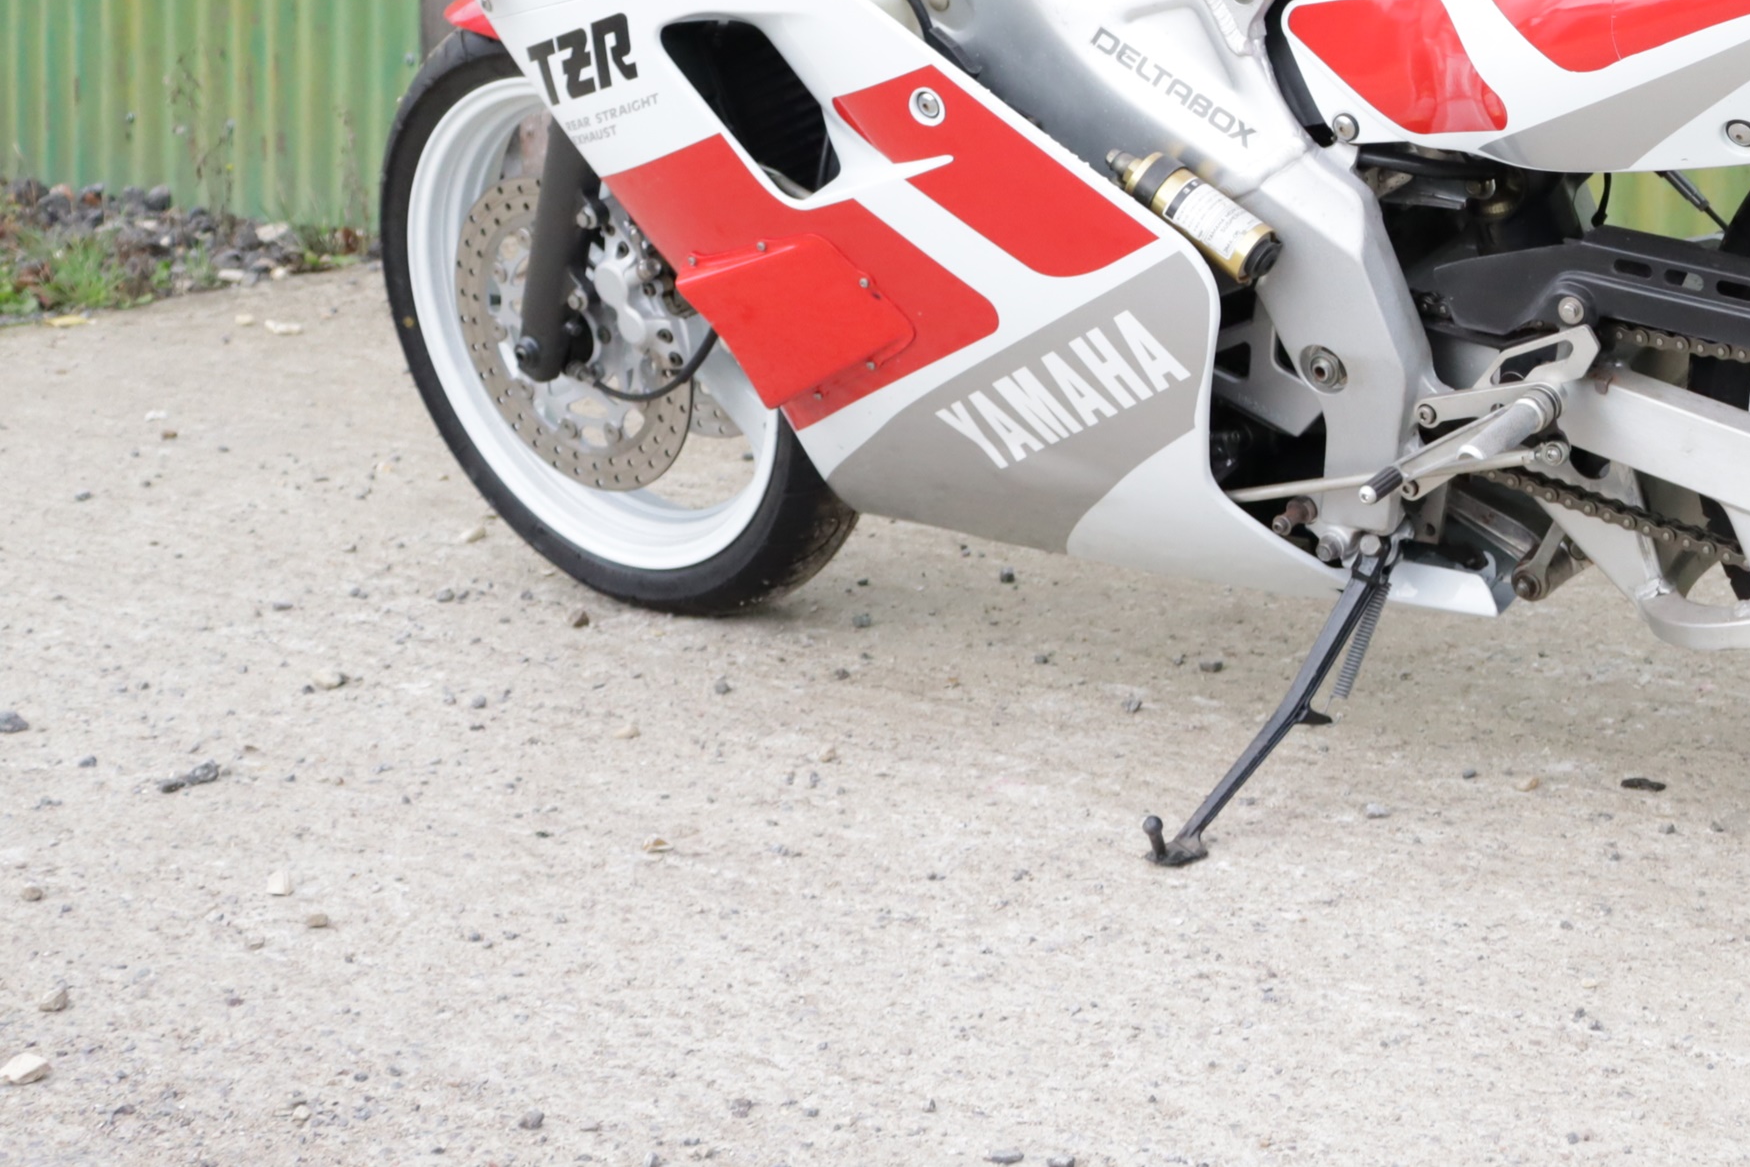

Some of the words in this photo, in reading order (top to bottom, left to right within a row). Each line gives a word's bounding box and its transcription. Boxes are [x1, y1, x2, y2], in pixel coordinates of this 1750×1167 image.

[526, 12, 638, 106] TZR
[565, 116, 591, 132] REAR
[595, 93, 659, 125] STRAIGHT
[1089, 26, 1257, 150] DELTABOX
[935, 309, 1191, 469] YAMAHA
